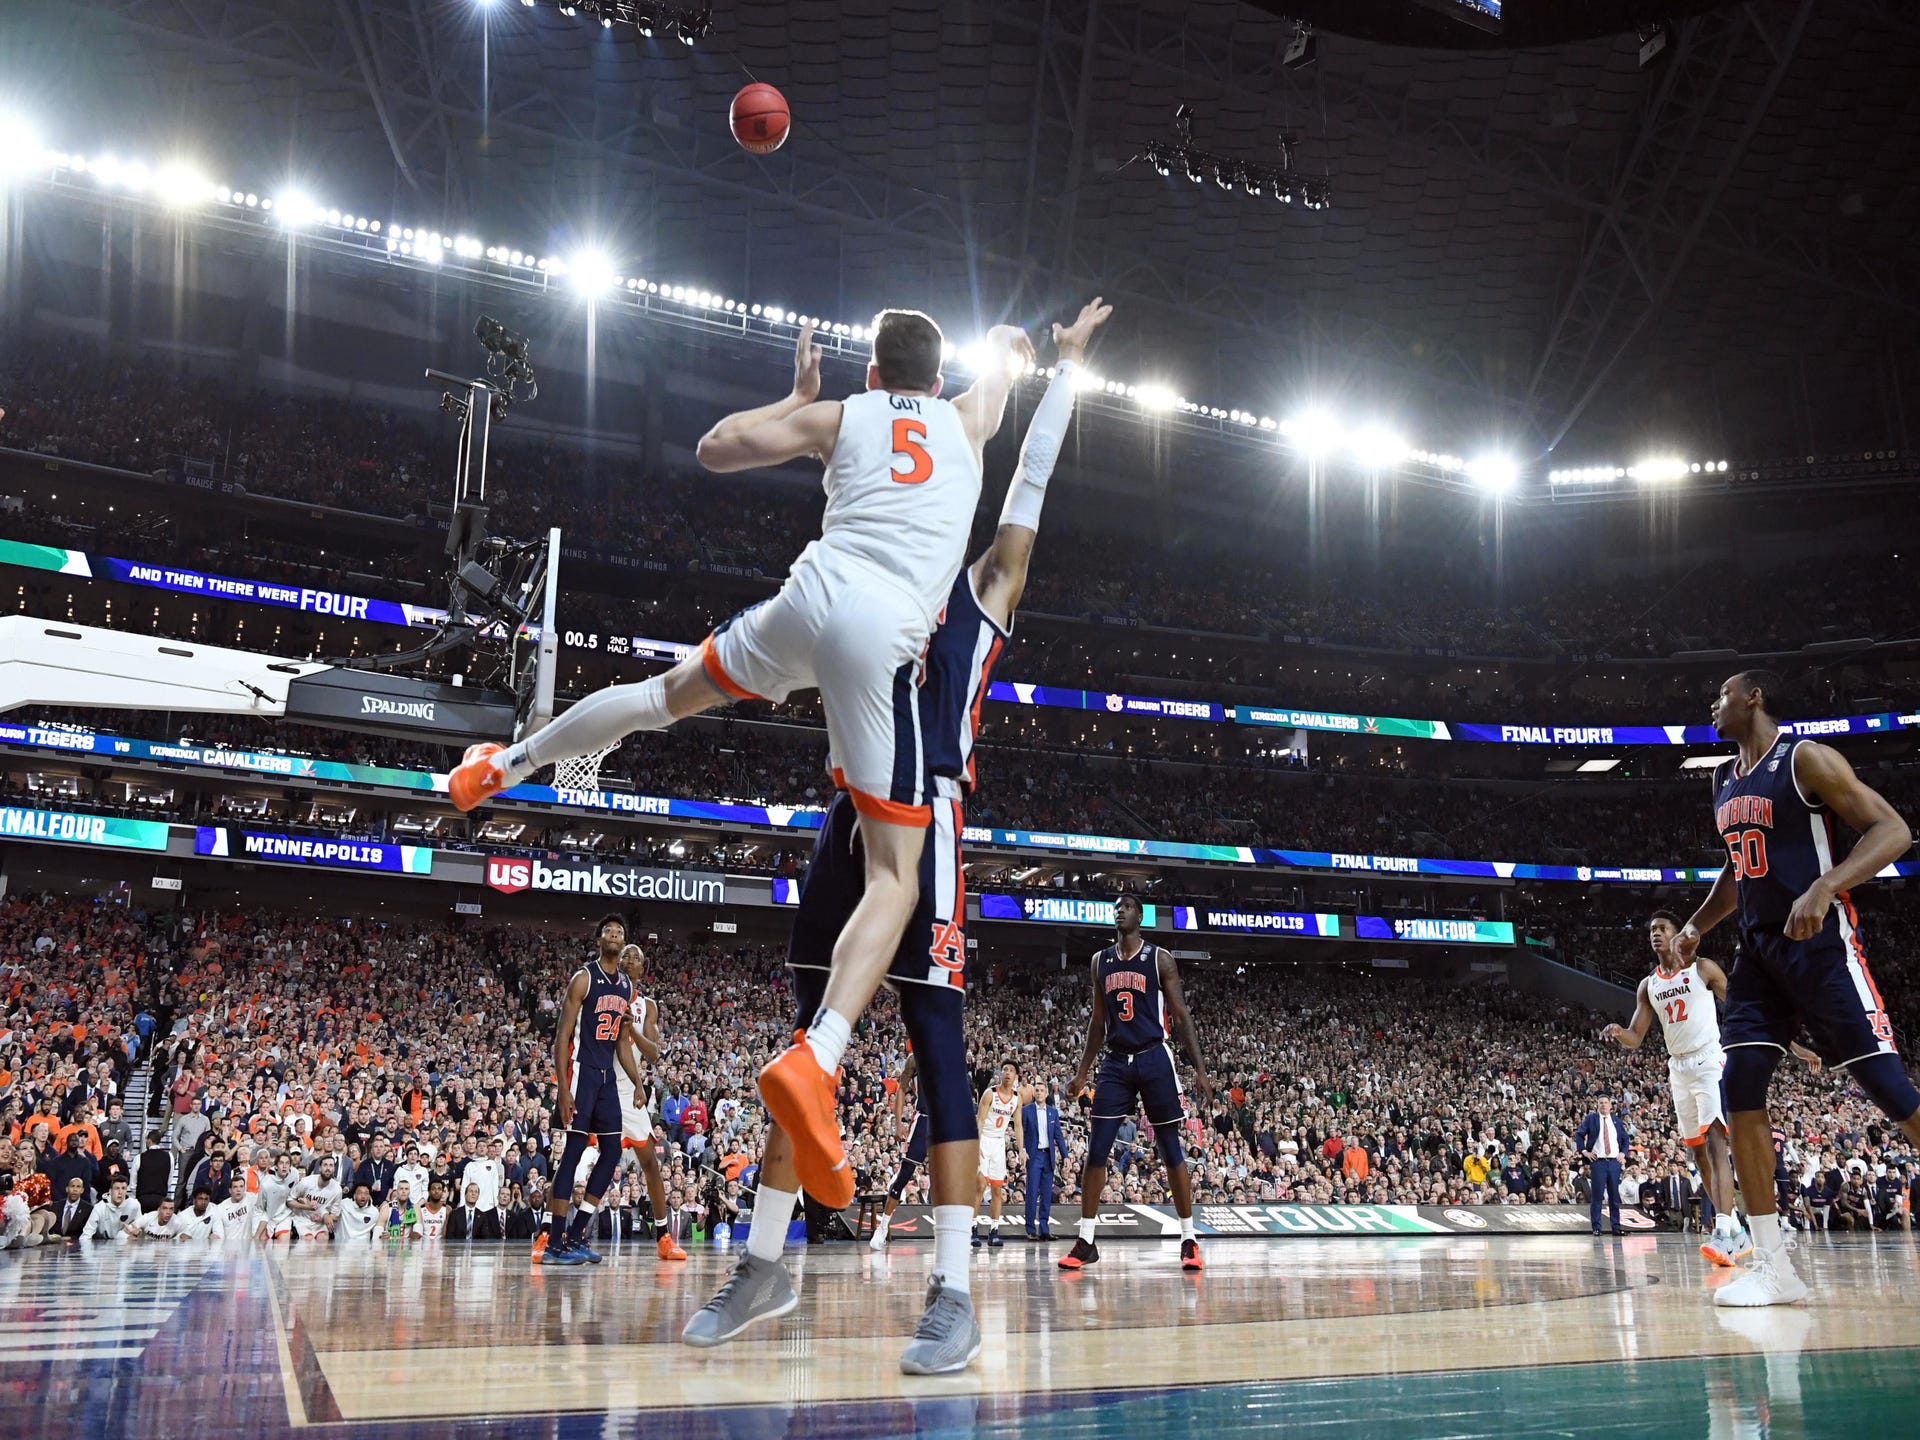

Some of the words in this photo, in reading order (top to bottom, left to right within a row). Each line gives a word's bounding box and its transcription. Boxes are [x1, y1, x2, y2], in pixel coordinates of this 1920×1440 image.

[889, 394, 921, 414] GUY
[890, 418, 933, 485] 5
[610, 555, 627, 566] RING
[129, 566, 161, 582] AND
[164, 571, 204, 588] THEN
[208, 578, 254, 596] THERE
[258, 586, 298, 603] WERE
[300, 589, 369, 619] FOUR
[565, 631, 598, 649] 00.5
[607, 644, 629, 654] HALF
[610, 636, 628, 646] 2ND
[361, 696, 435, 721] SPALDING
[1127, 700, 1160, 711] AUBURN
[1161, 701, 1210, 718] TIGERS
[1250, 711, 1289, 723] VIRGINIA
[1290, 712, 1359, 730] CAVALIERS
[1501, 726, 1551, 743] FINAL
[1553, 728, 1600, 744] FOUR
[1793, 719, 1850, 735] TIGERS
[28, 728, 95, 750] TIGERS
[150, 745, 200, 761] VIRGINIA
[203, 749, 292, 773] CAVALIERS
[557, 788, 609, 808] FINAL
[612, 793, 658, 813] FOUR
[246, 836, 383, 864] MINNEAPOLIS
[1029, 834, 1065, 845] VIRGINIA
[1067, 836, 1130, 851] CAVALIERS
[1331, 854, 1371, 869] FINAL
[1373, 856, 1409, 872] FOUR
[1723, 829, 1769, 881] 50
[154, 879, 164, 887] V1
[169, 880, 180, 888] V2
[1621, 868, 1662, 881] TIGERS
[1024, 898, 1115, 923] #FINALFOUR
[1208, 912, 1304, 930] MINNEAPOLIS
[1394, 919, 1476, 941] #FINALFOUR
[1105, 971, 1146, 995] AUBURN
[1654, 985, 1691, 1002] VIRGINIA
[1116, 991, 1134, 1021] 3
[1664, 999, 1688, 1024] 12
[595, 1012, 622, 1041] 24
[996, 1116, 1004, 1128] 0
[1231, 1205, 1394, 1232] FOUR
[1504, 1212, 1590, 1223] AUBURN
[429, 1225, 437, 1237] 2
